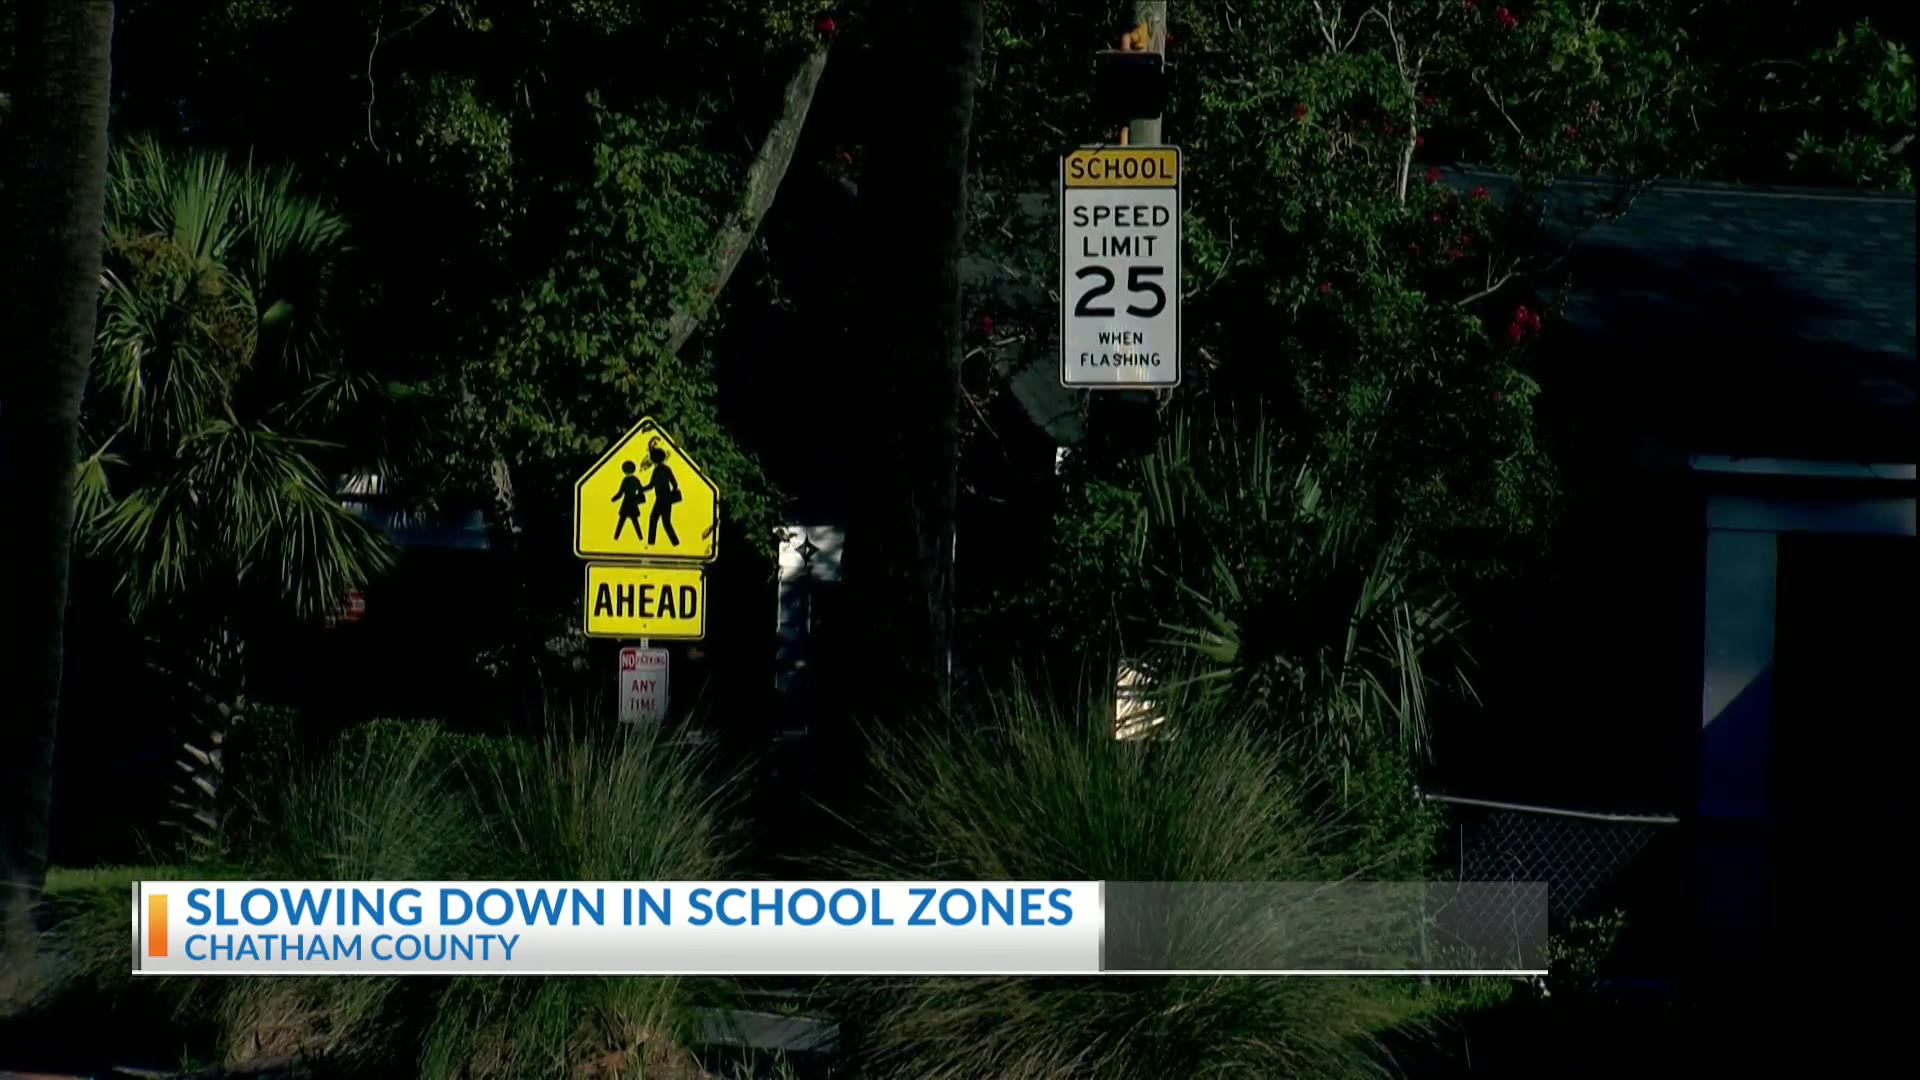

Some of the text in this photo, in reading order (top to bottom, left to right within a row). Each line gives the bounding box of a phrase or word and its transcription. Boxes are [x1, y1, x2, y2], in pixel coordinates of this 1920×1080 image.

[1071, 157, 1173, 180] SCHOOL
[1073, 205, 1170, 228] SPEED
[1083, 236, 1158, 258] LIMIT
[1074, 265, 1167, 319] 25
[1098, 331, 1144, 346] WHEN
[1080, 352, 1161, 368] FLASHING
[593, 582, 698, 620] AHEAD
[622, 653, 635, 668] NO
[632, 679, 656, 693] ANY
[630, 698, 656, 712] TIME
